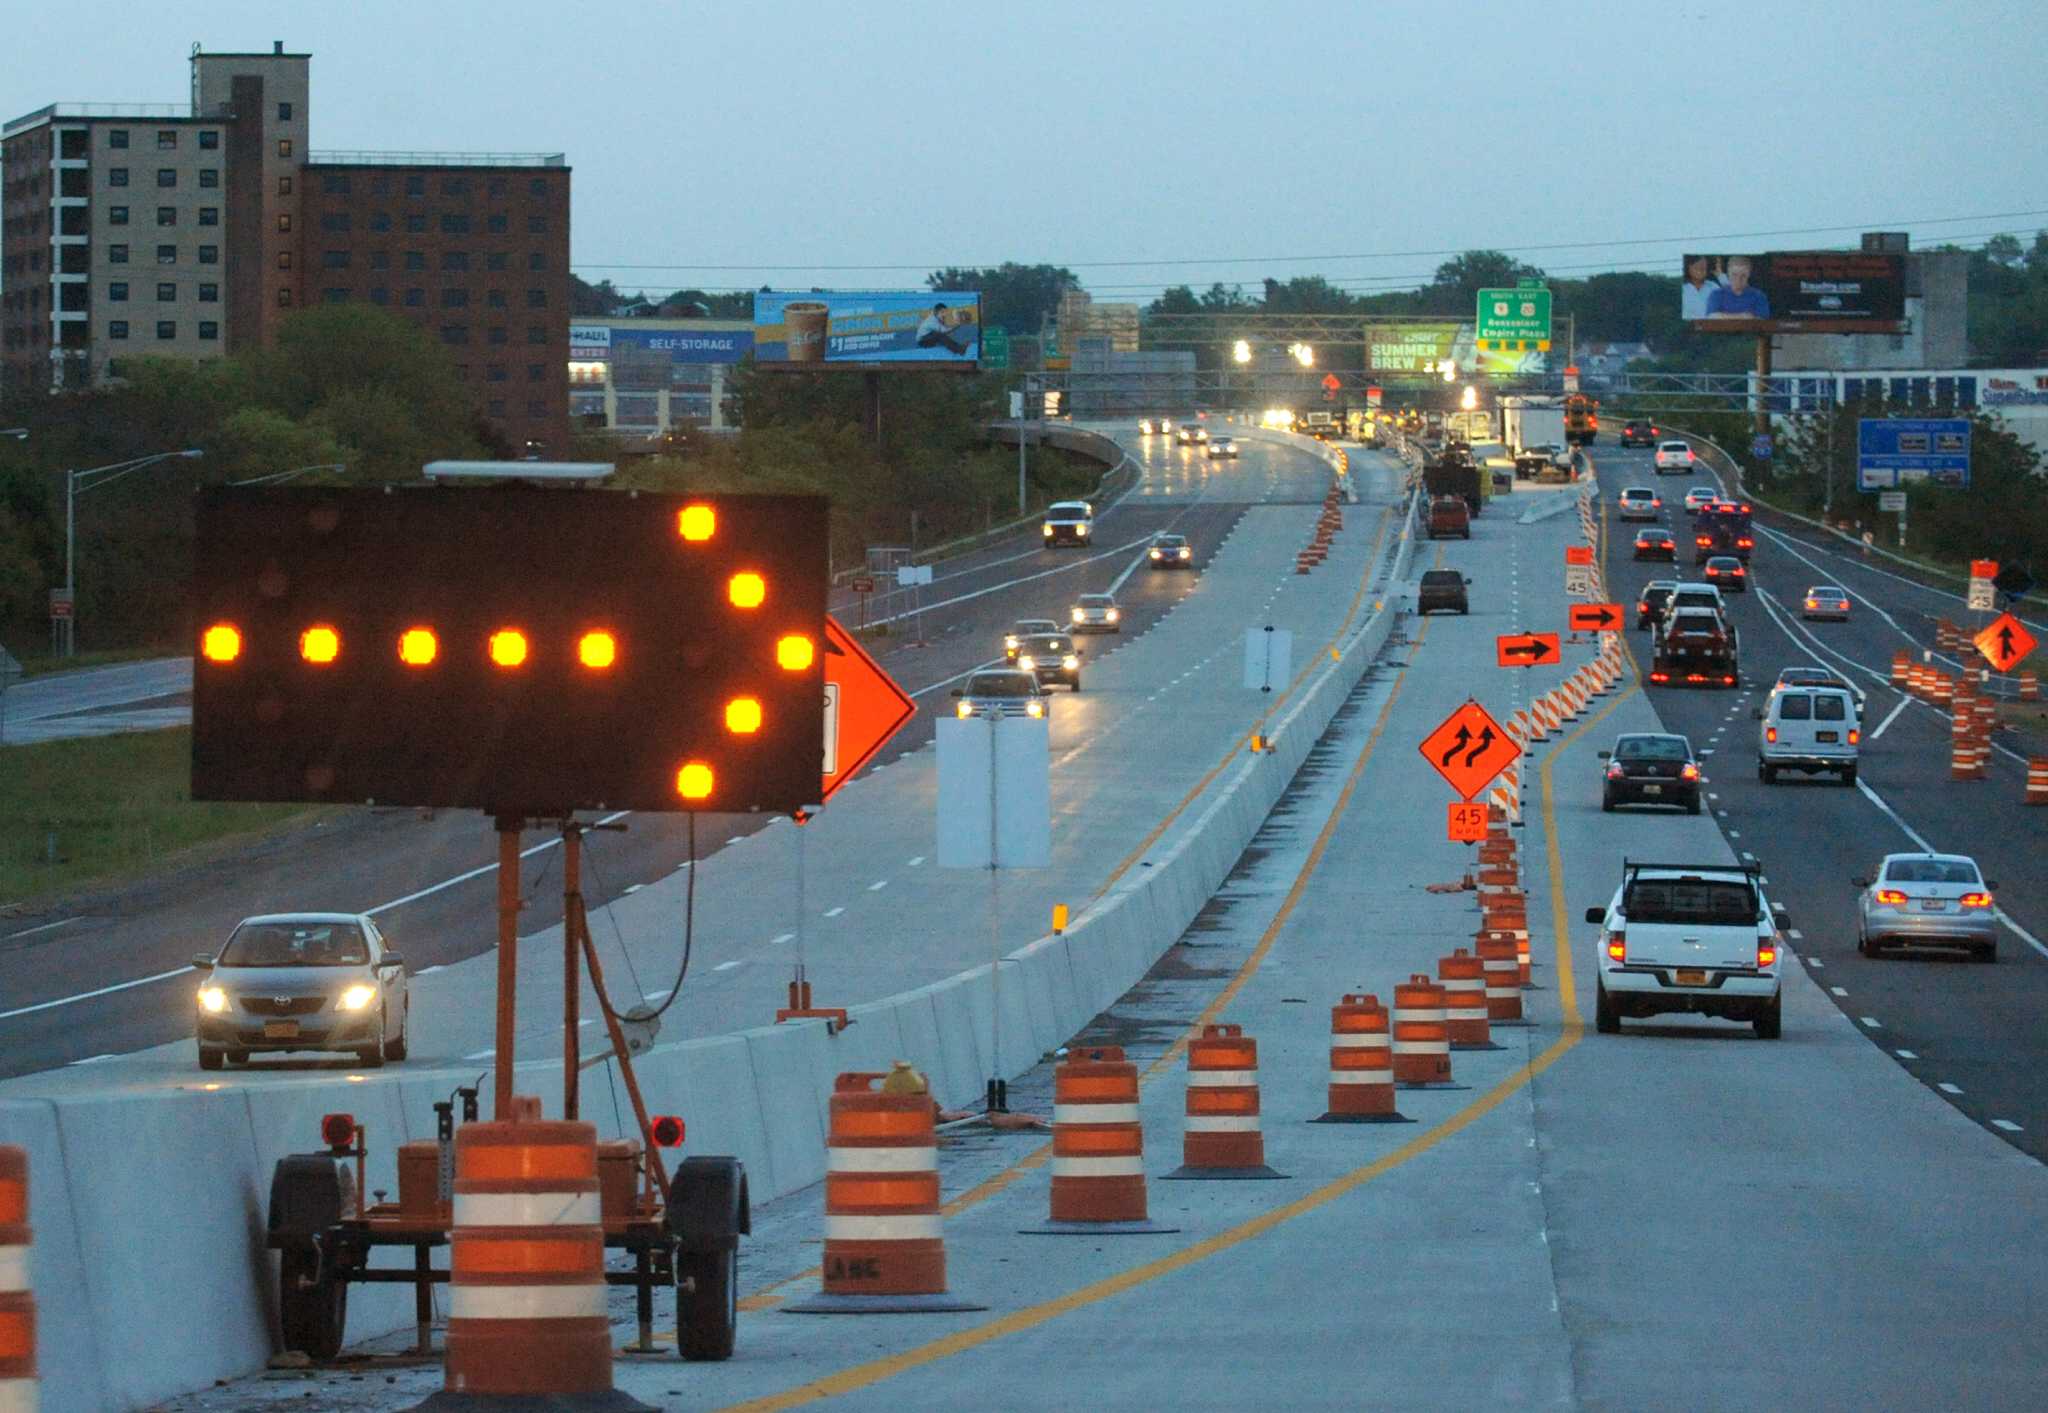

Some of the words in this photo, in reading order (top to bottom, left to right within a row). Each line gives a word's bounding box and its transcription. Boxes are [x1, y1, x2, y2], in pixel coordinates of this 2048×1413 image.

[649, 338, 734, 351] SELF-STORAGE
[1371, 343, 1438, 356] SUMMER
[1371, 356, 1416, 370] BREW
[1567, 581, 1587, 593] 45
[1455, 809, 1481, 825] 45
